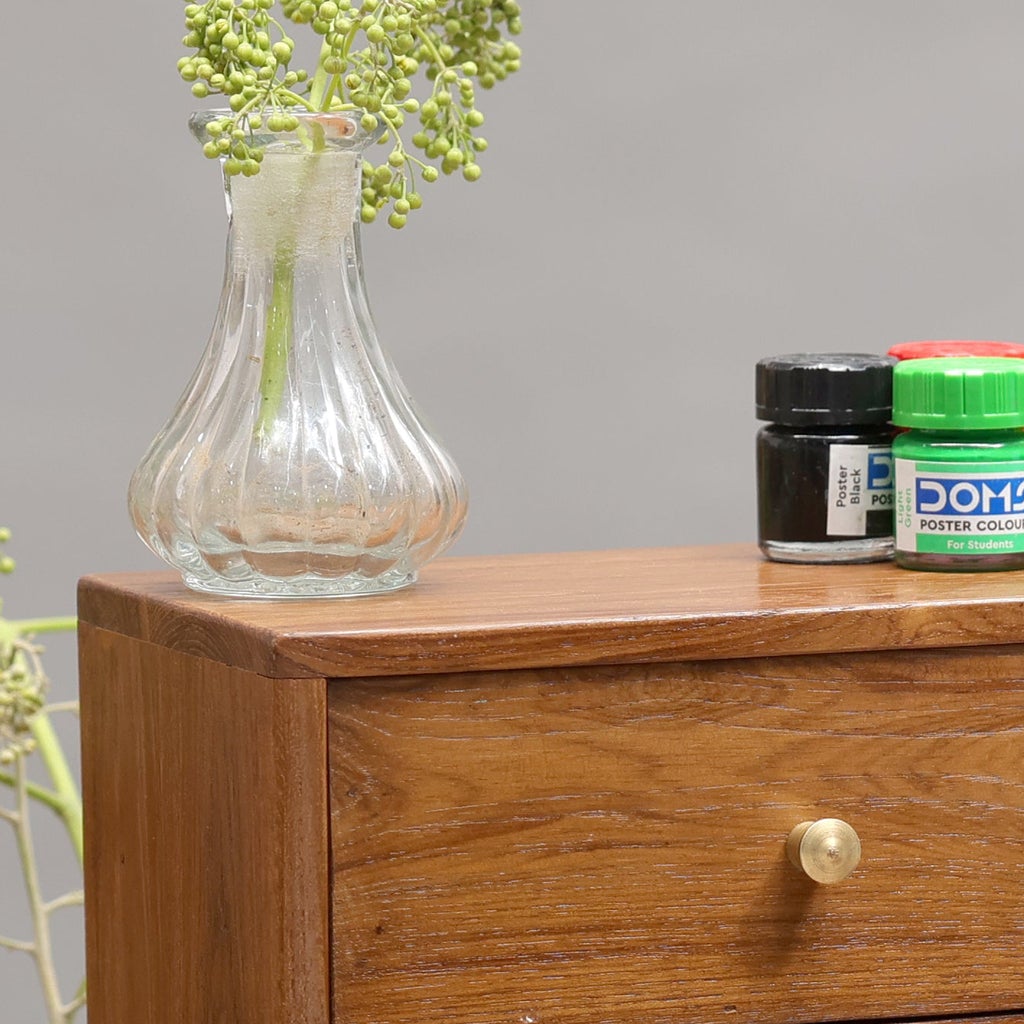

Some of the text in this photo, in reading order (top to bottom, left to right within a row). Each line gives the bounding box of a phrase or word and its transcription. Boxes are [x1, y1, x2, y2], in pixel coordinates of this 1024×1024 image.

[836, 465, 848, 508] Poster
[849, 468, 861, 504] Black
[920, 519, 973, 532] POSTER
[947, 539, 1014, 550] For Students
